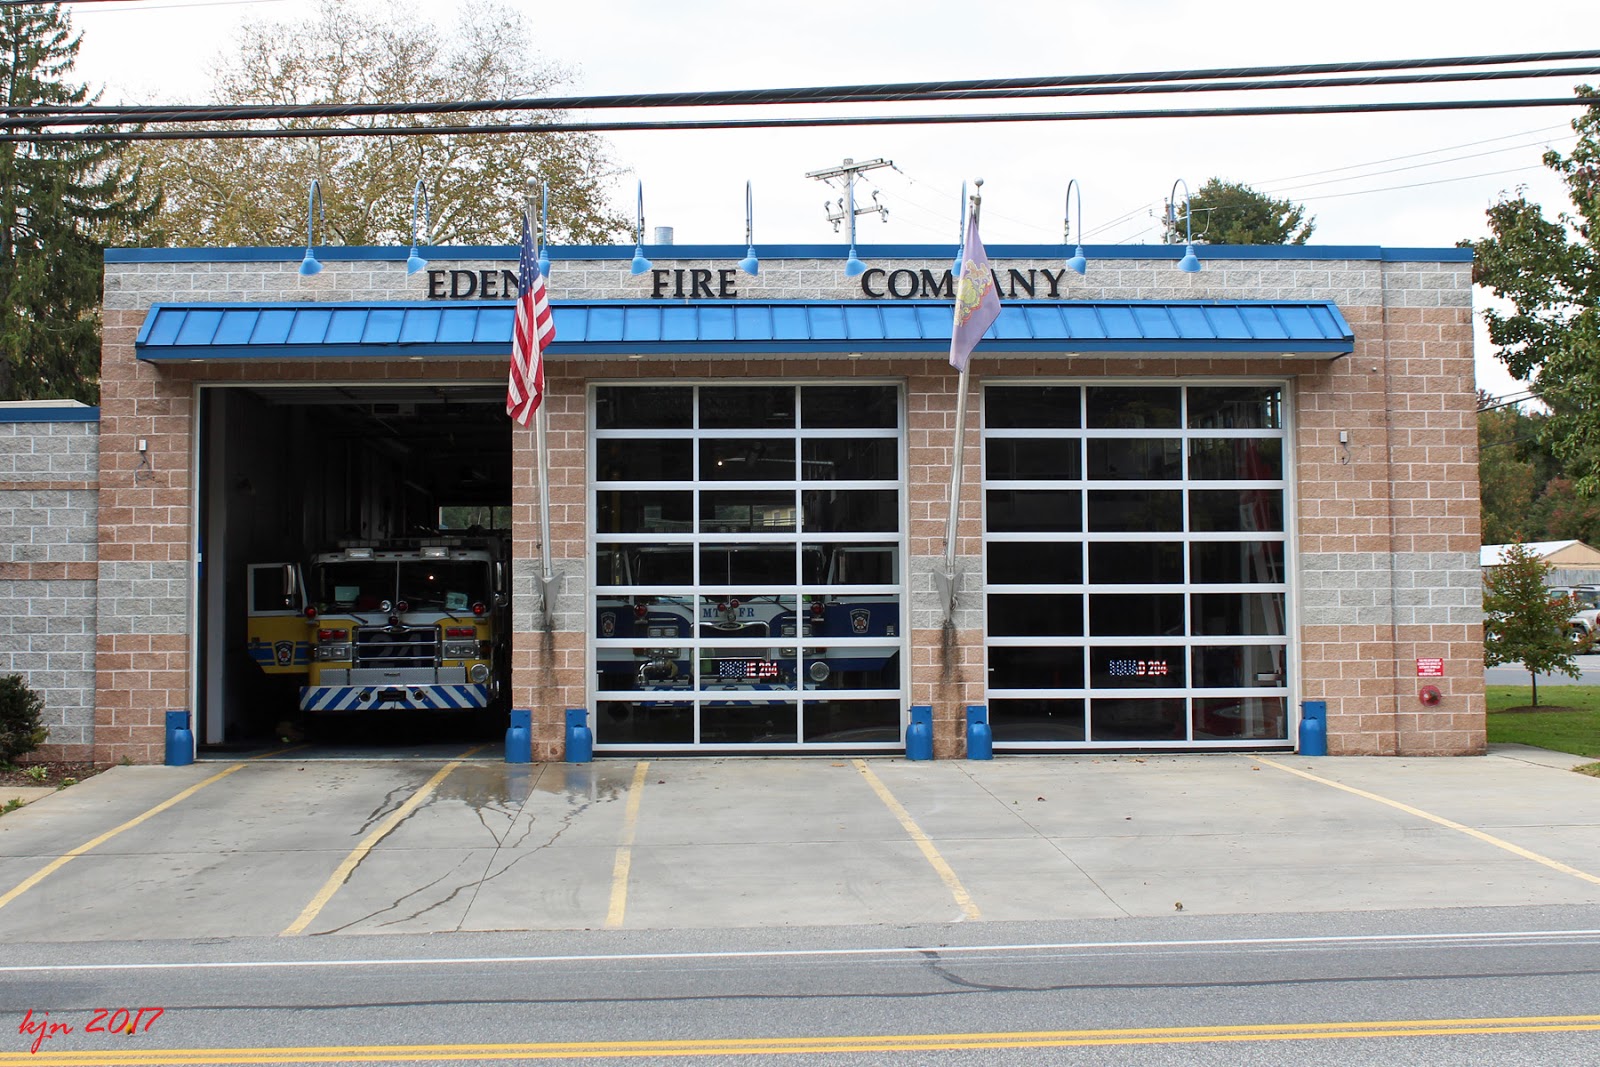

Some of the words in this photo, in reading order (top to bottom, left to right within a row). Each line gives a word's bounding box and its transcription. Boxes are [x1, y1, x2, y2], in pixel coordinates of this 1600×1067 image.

[651, 268, 738, 298] FIRE
[758, 661, 778, 678] 204
[1109, 659, 1146, 676] SQUAD
[1147, 660, 1168, 676] 204
